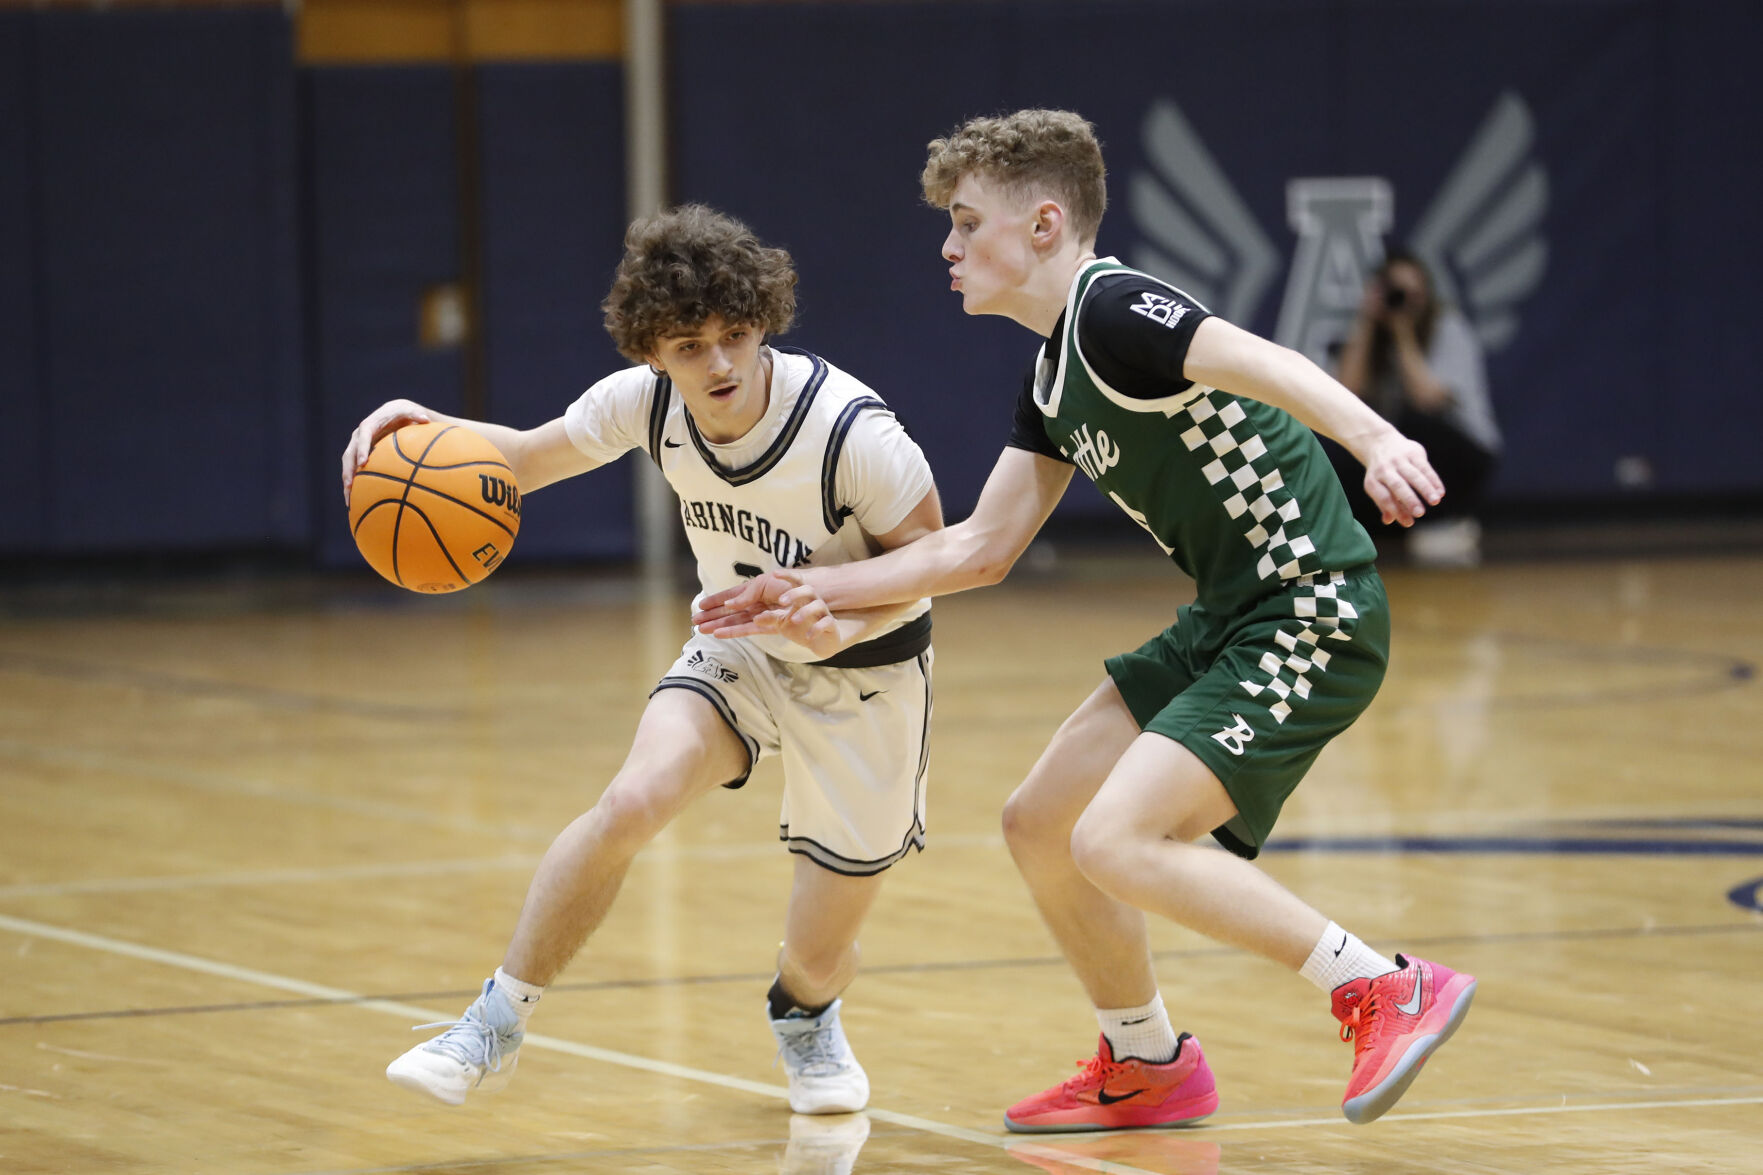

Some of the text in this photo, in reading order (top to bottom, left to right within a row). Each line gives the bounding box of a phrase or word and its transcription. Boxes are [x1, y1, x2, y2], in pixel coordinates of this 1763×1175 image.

[683, 499, 814, 568] ABINGDON
[472, 542, 506, 574] EV
[1210, 712, 1255, 756] B
